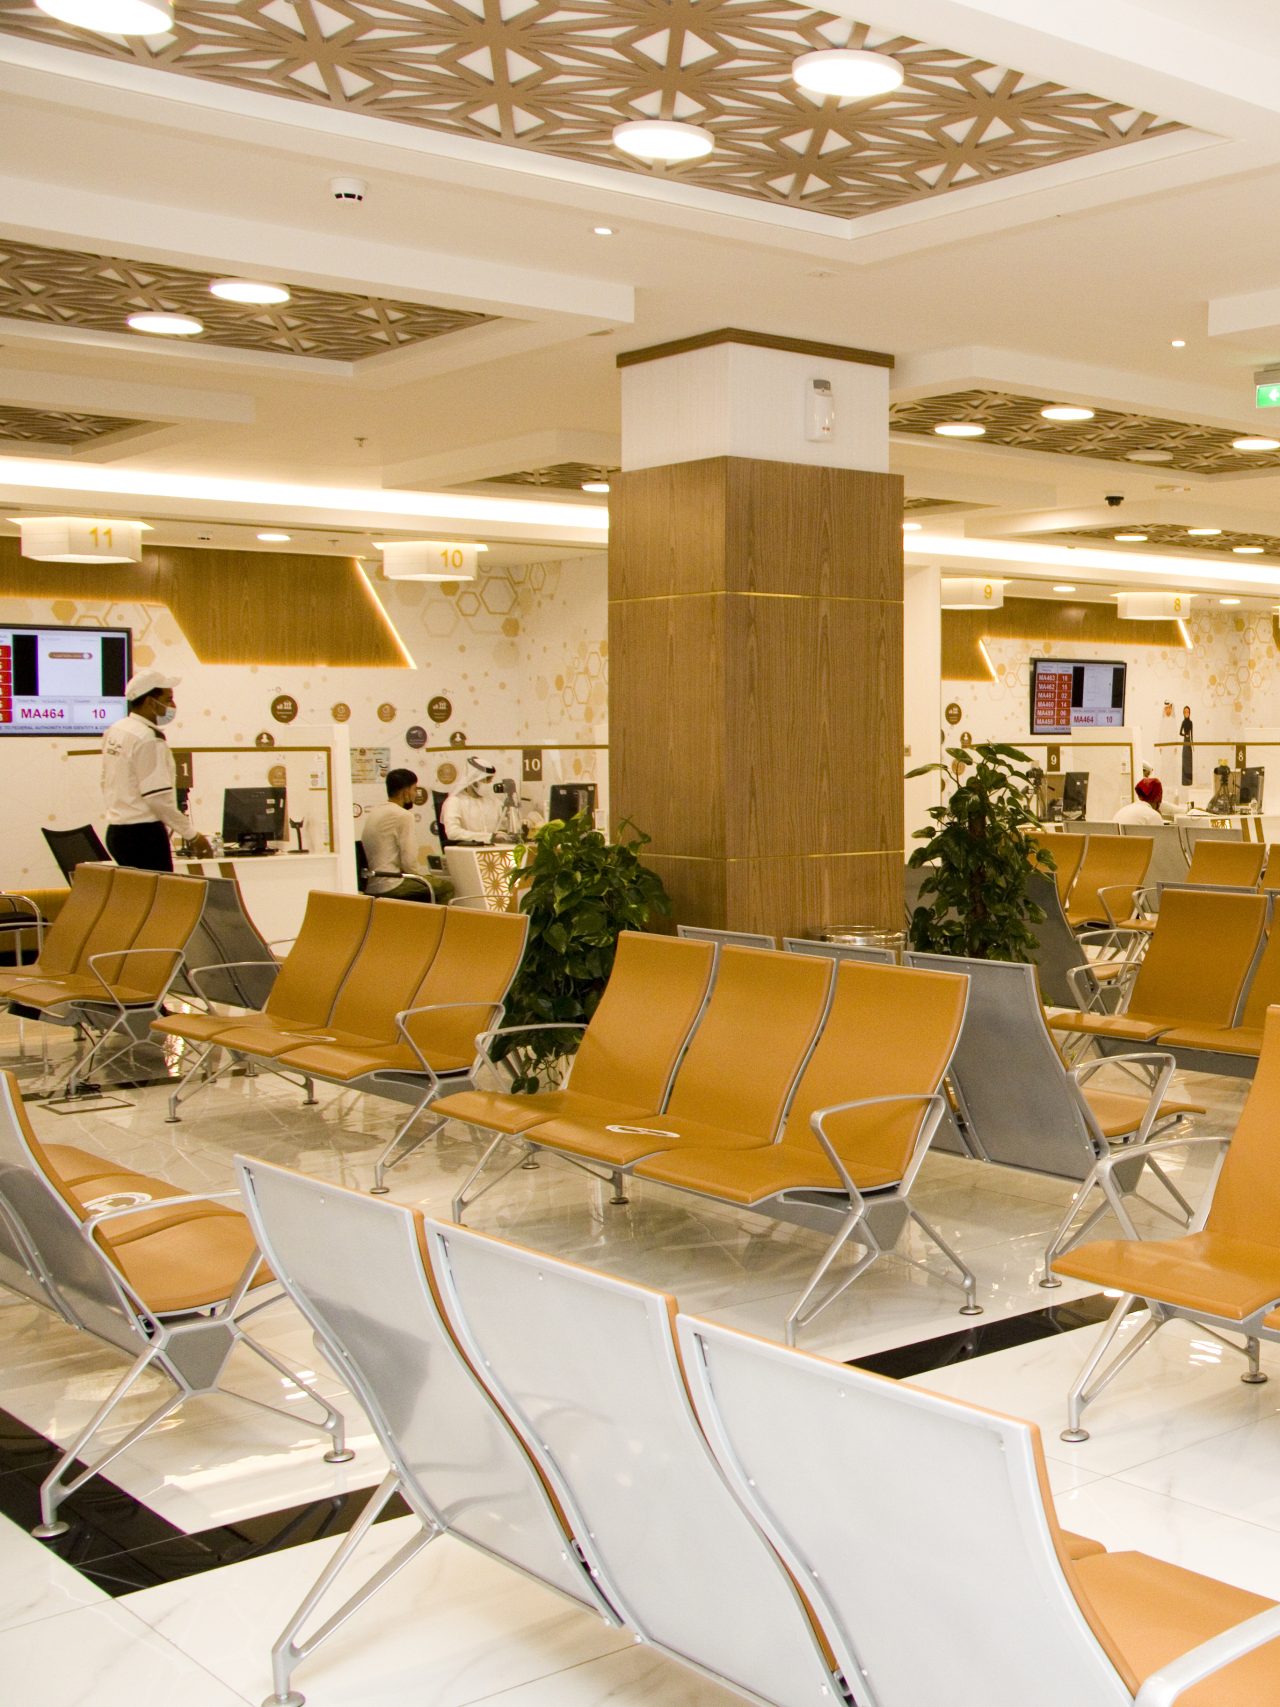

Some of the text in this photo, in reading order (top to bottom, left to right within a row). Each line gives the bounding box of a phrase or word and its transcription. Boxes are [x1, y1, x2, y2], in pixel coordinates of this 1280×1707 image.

[89, 526, 113, 549] 11
[440, 549, 464, 569] 10
[984, 584, 993, 600] 9
[1174, 598, 1182, 612] 8
[21, 708, 106, 719] MA464 10
[1073, 715, 1113, 723] MA464 10
[1050, 754, 1057, 765] 9
[1238, 750, 1244, 762] 8
[523, 758, 541, 772] 10
